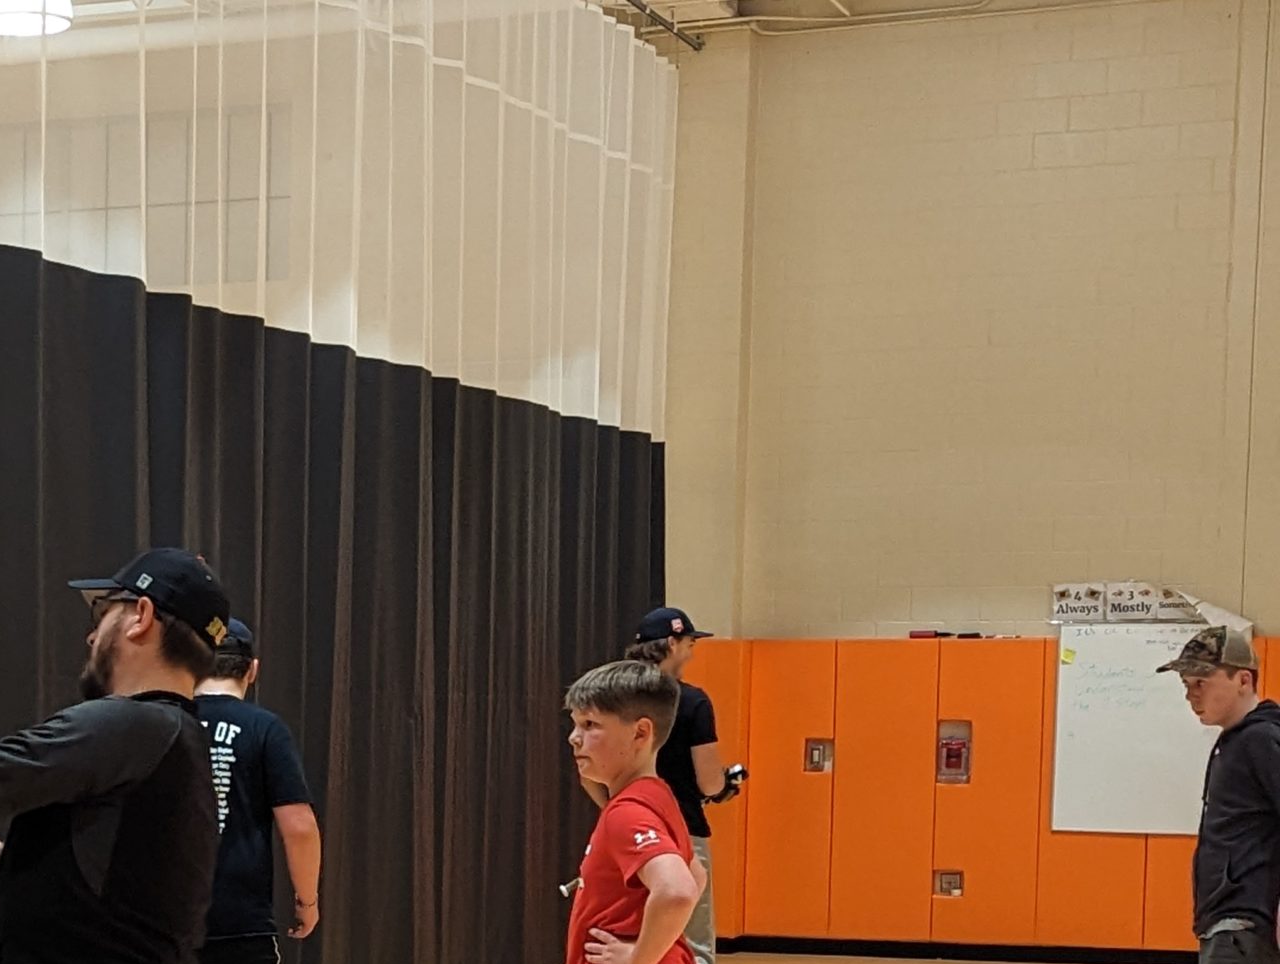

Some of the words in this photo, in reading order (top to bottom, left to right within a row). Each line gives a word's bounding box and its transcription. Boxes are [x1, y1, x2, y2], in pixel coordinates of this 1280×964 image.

[1073, 591, 1082, 602] 4
[1127, 590, 1135, 601] 3
[1056, 603, 1099, 616] Always
[1110, 602, 1152, 615] Mostly
[214, 721, 241, 745] OF
